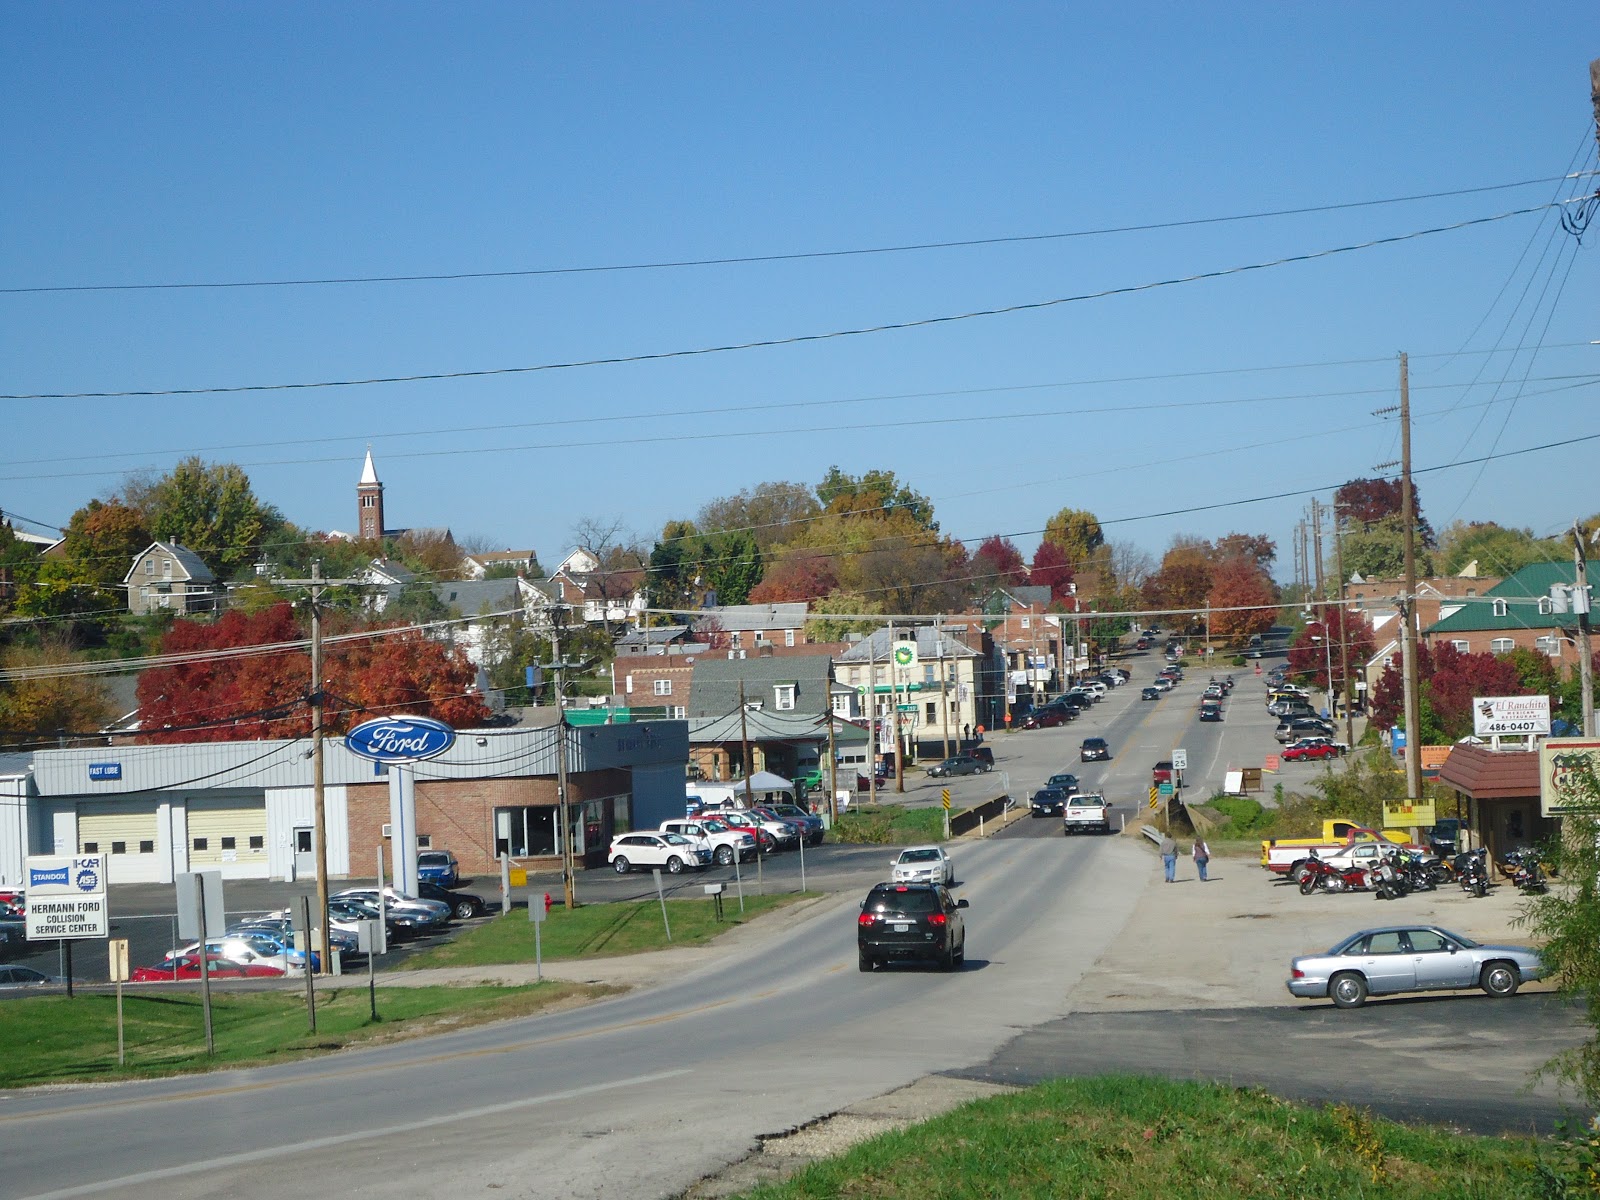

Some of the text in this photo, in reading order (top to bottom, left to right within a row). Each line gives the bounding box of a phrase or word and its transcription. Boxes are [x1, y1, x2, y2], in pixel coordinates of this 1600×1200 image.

[1495, 699, 1546, 711] El Ranchito
[1489, 722, 1535, 731] 486-0407
[367, 726, 430, 753] Ford
[90, 766, 119, 775] FAST LUBE
[73, 859, 99, 868] I-CAR
[33, 873, 66, 881] STANDOX
[79, 875, 95, 884] ASE
[31, 902, 100, 914] HERMANN FORD
[46, 914, 85, 924] COLLISION
[35, 924, 98, 934] SERVICE CENTER
